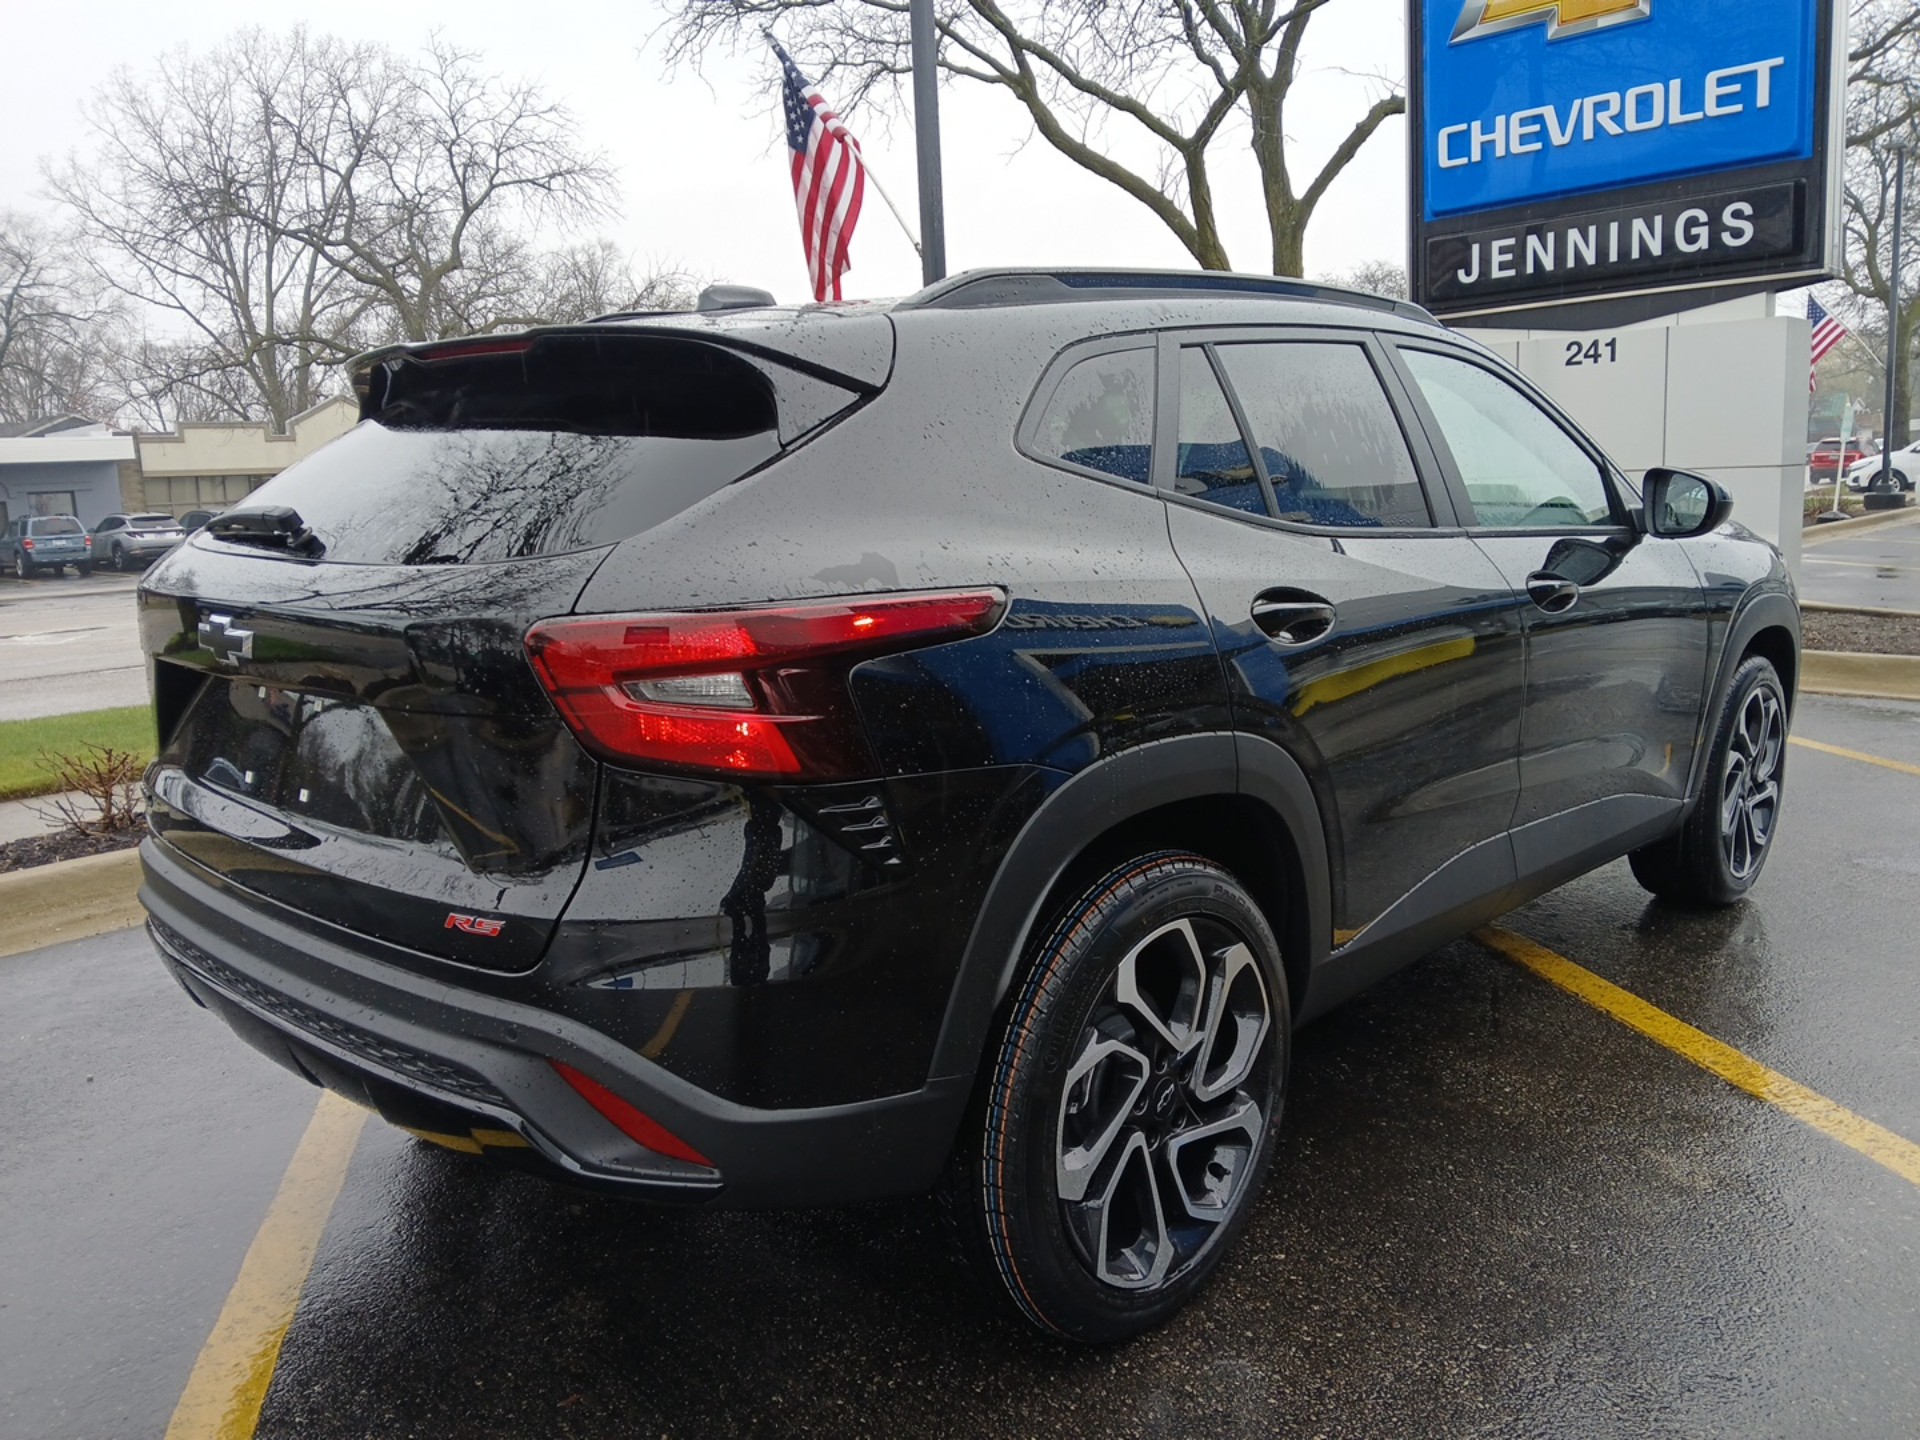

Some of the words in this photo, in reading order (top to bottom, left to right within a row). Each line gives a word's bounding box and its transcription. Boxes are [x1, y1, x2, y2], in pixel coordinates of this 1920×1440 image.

[1438, 56, 1784, 168] CHEVROLET
[1457, 201, 1755, 284] JENNINGS
[1565, 337, 1616, 366] 241
[444, 912, 506, 937] RS
